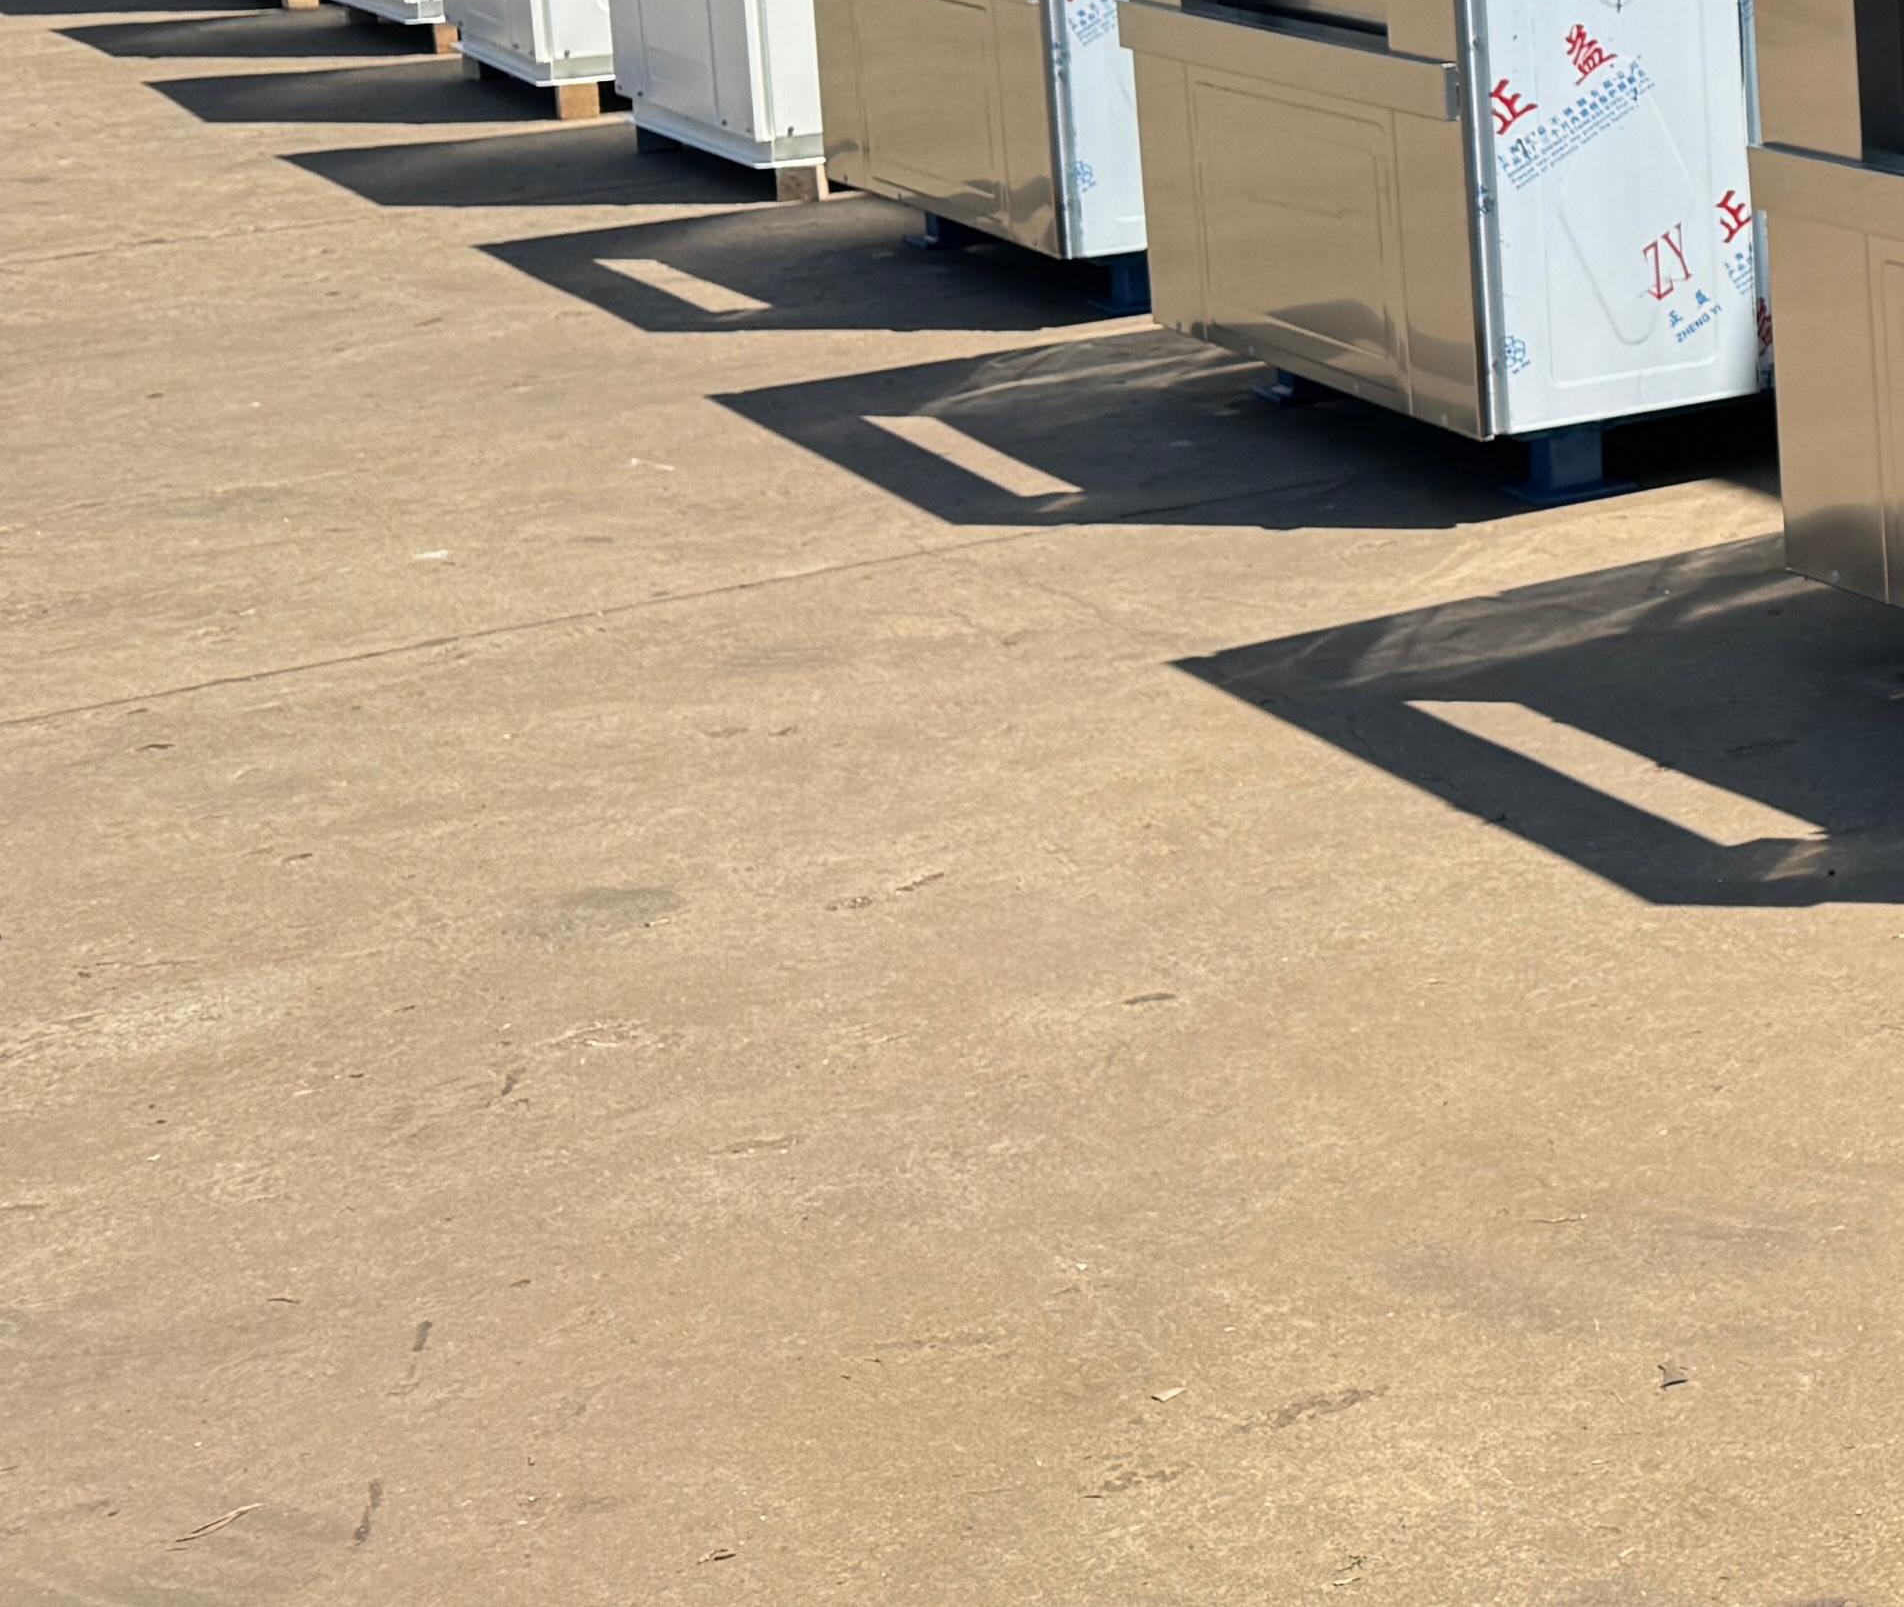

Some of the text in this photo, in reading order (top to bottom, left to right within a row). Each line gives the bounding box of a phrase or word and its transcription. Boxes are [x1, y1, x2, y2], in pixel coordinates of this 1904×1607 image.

[1641, 223, 1693, 301] ZY
[1676, 303, 1723, 343] ZHENG YI
